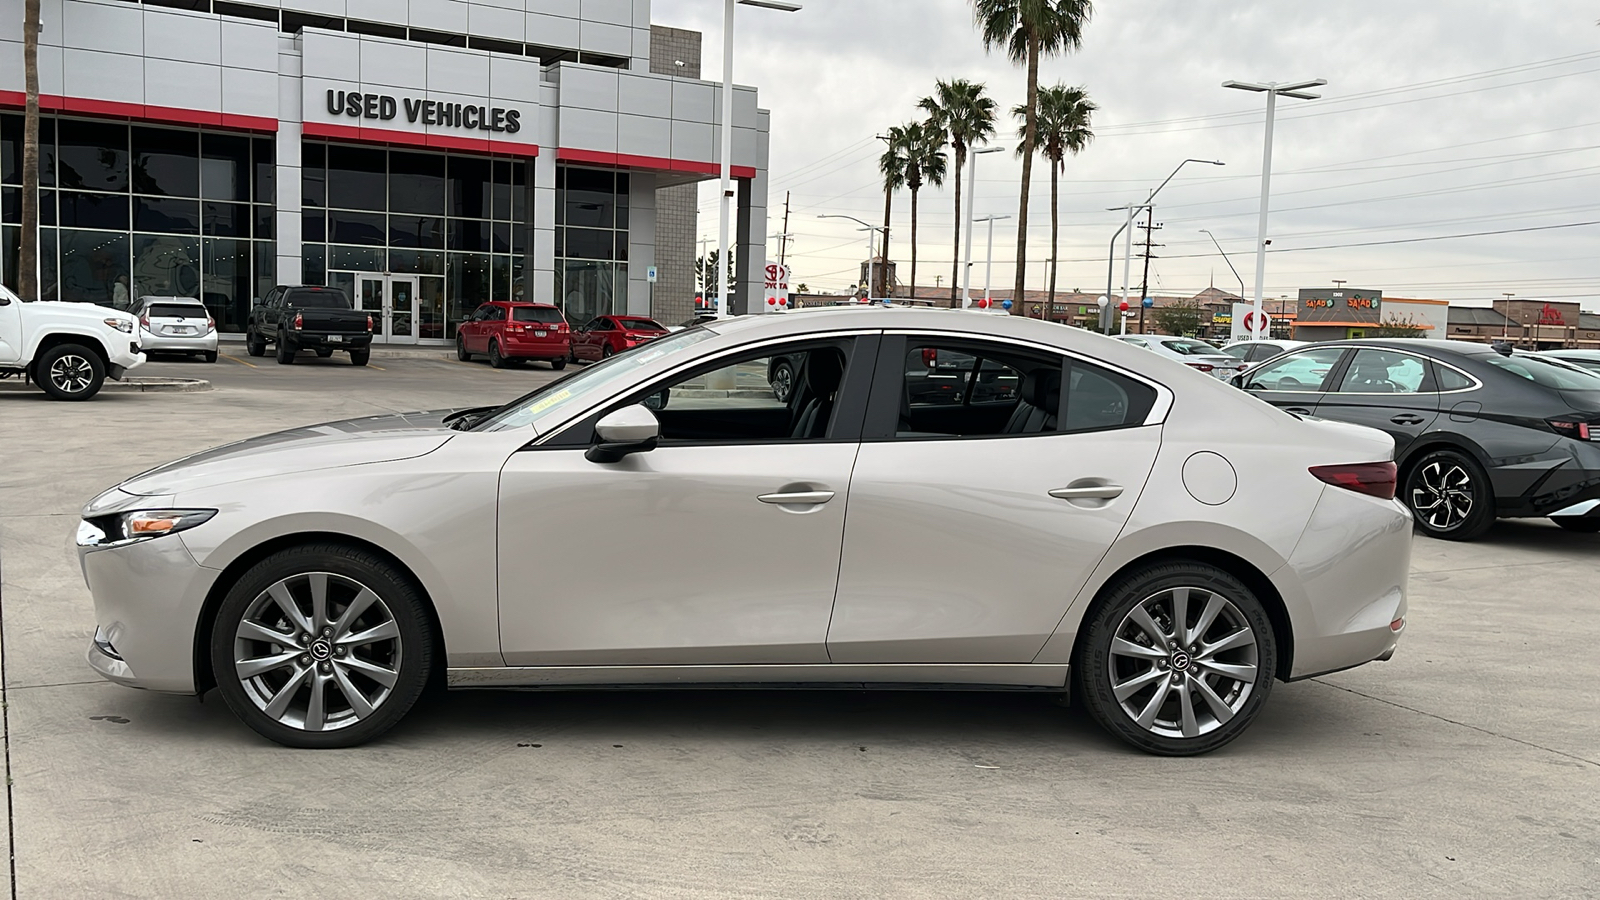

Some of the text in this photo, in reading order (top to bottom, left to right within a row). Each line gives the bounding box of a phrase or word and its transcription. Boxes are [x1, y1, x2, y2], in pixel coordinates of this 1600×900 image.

[327, 89, 521, 134] USED VEHICLES
[765, 282, 788, 290] OYOTA
